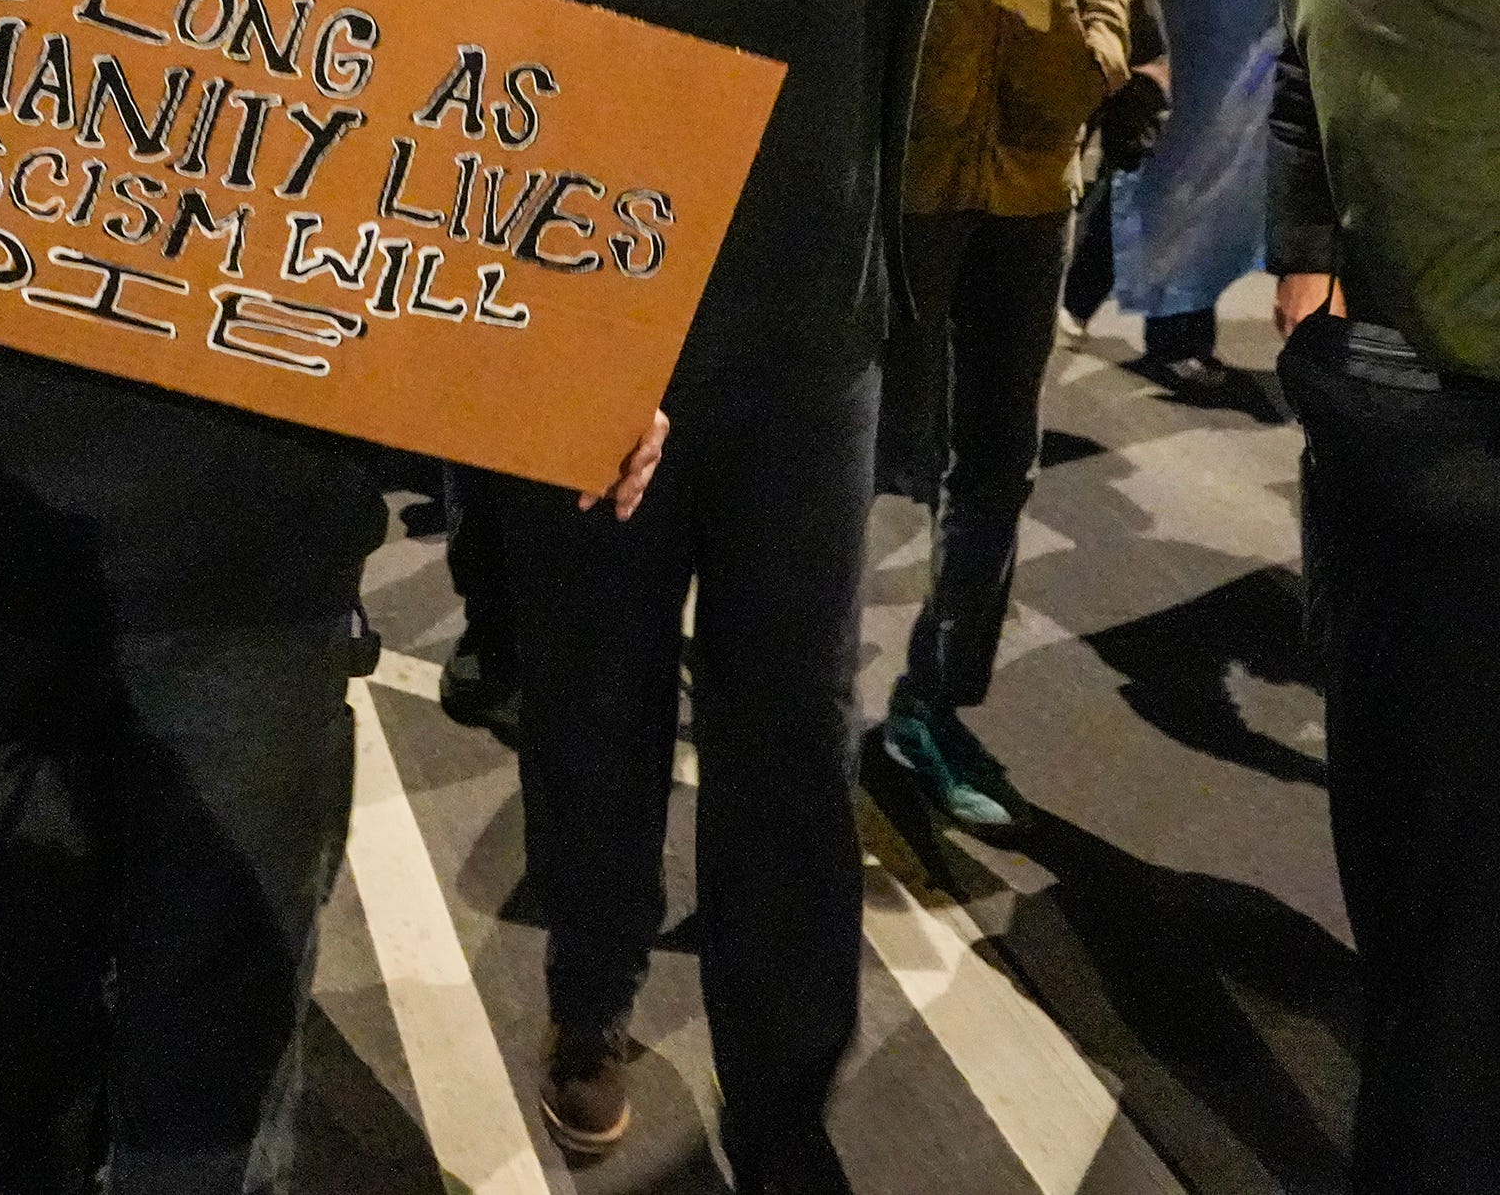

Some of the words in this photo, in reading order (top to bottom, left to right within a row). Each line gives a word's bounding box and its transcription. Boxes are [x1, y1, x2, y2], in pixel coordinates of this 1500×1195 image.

[412, 44, 560, 151] AS
[377, 136, 676, 279] LIVES
[280, 211, 530, 328] WILL
